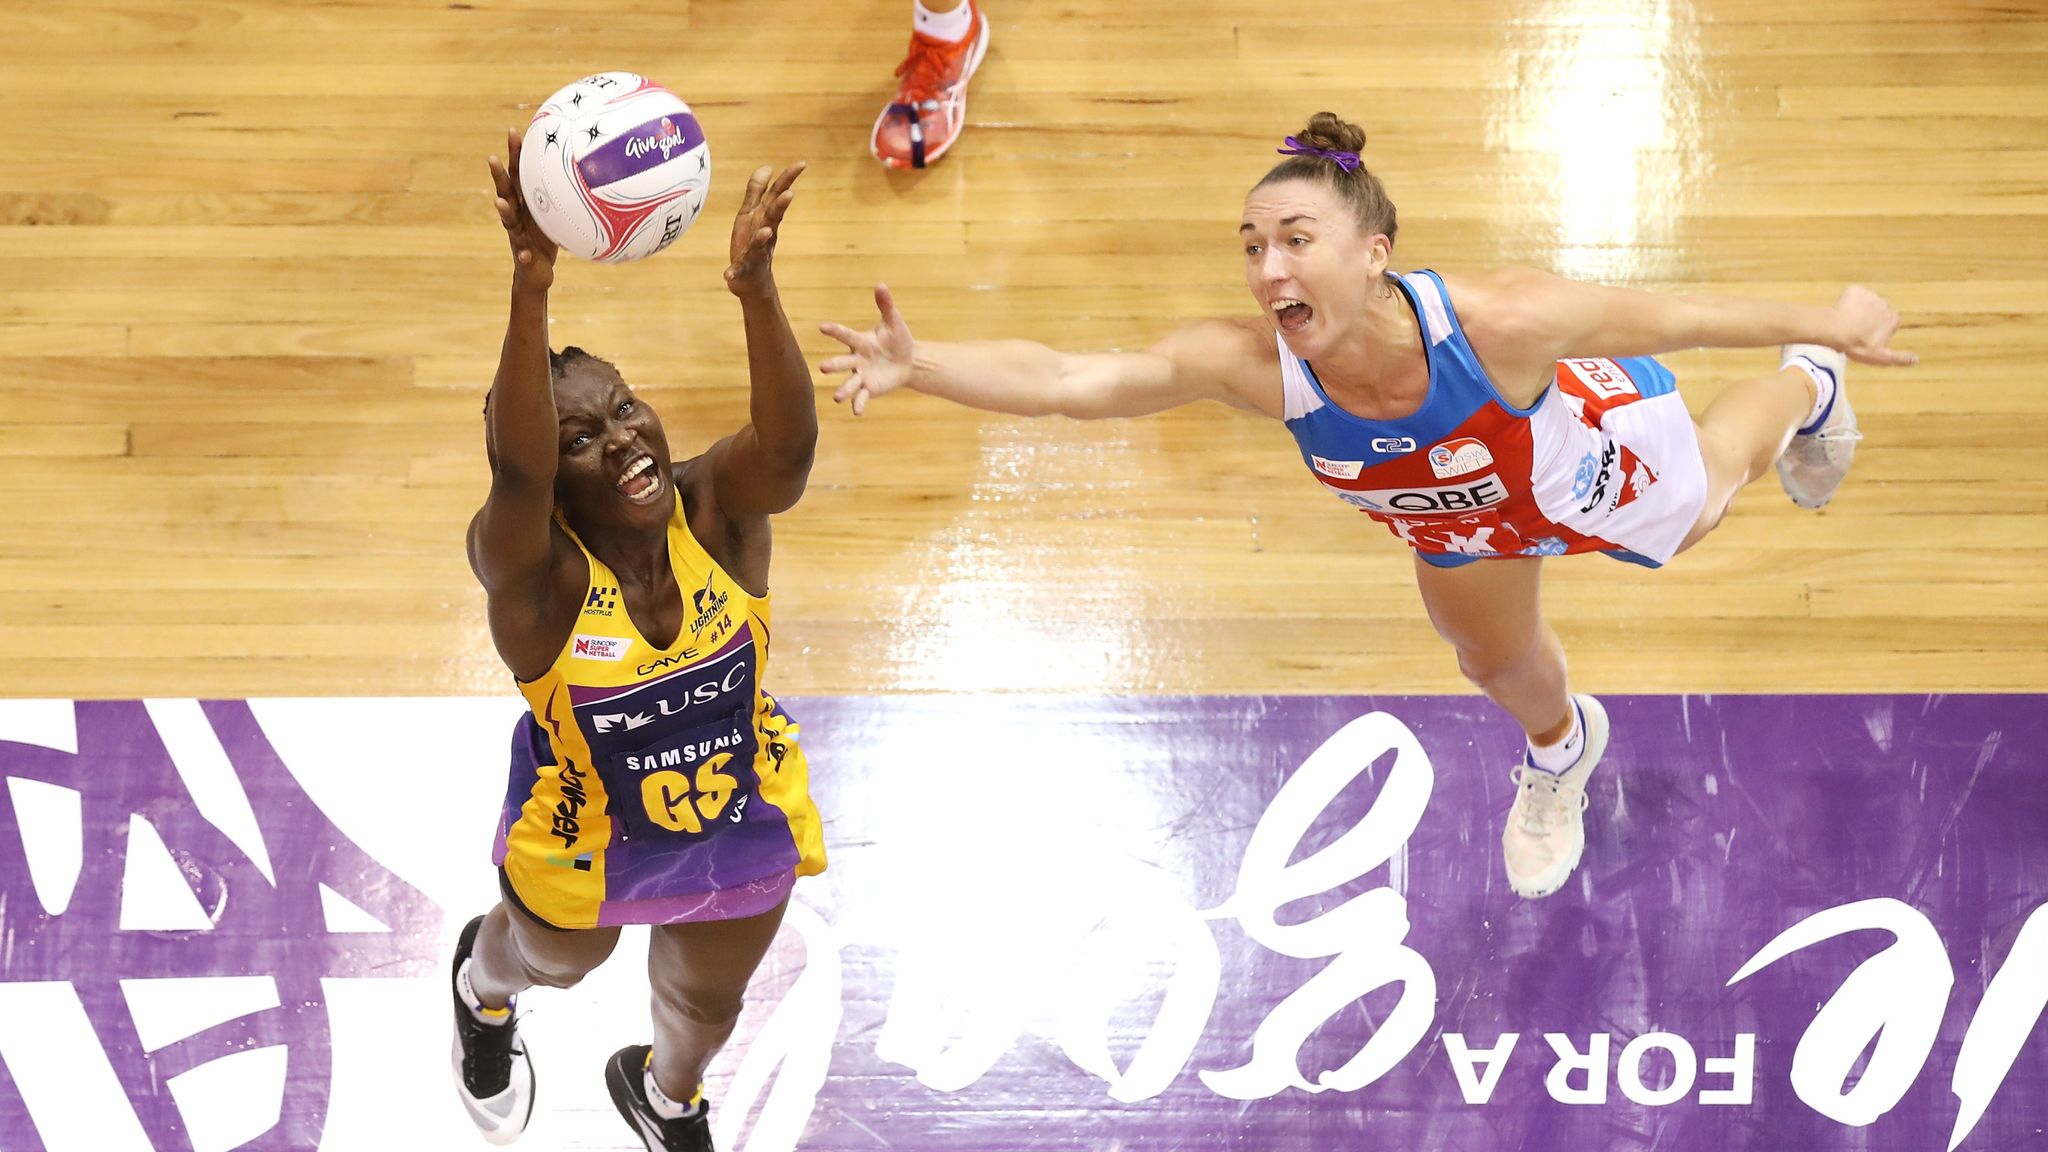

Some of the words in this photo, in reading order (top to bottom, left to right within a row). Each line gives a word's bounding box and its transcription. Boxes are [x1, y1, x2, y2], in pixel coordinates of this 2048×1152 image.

[625, 136, 659, 160] Give
[656, 125, 686, 161] goal
[1573, 360, 1623, 392] red
[1435, 456, 1492, 478] SWIFTS
[1388, 480, 1502, 512] QBE
[584, 609, 613, 617] HOSTPLUS
[689, 590, 729, 634] LIGHTNING
[589, 650, 617, 658] NETBALL
[590, 639, 618, 647] SUNCORP
[655, 661, 746, 716] USC
[626, 728, 743, 771] SAMSUNG
[640, 752, 739, 834] GS
[1441, 1032, 1521, 1106] A
[1543, 1031, 1757, 1107] FOR
